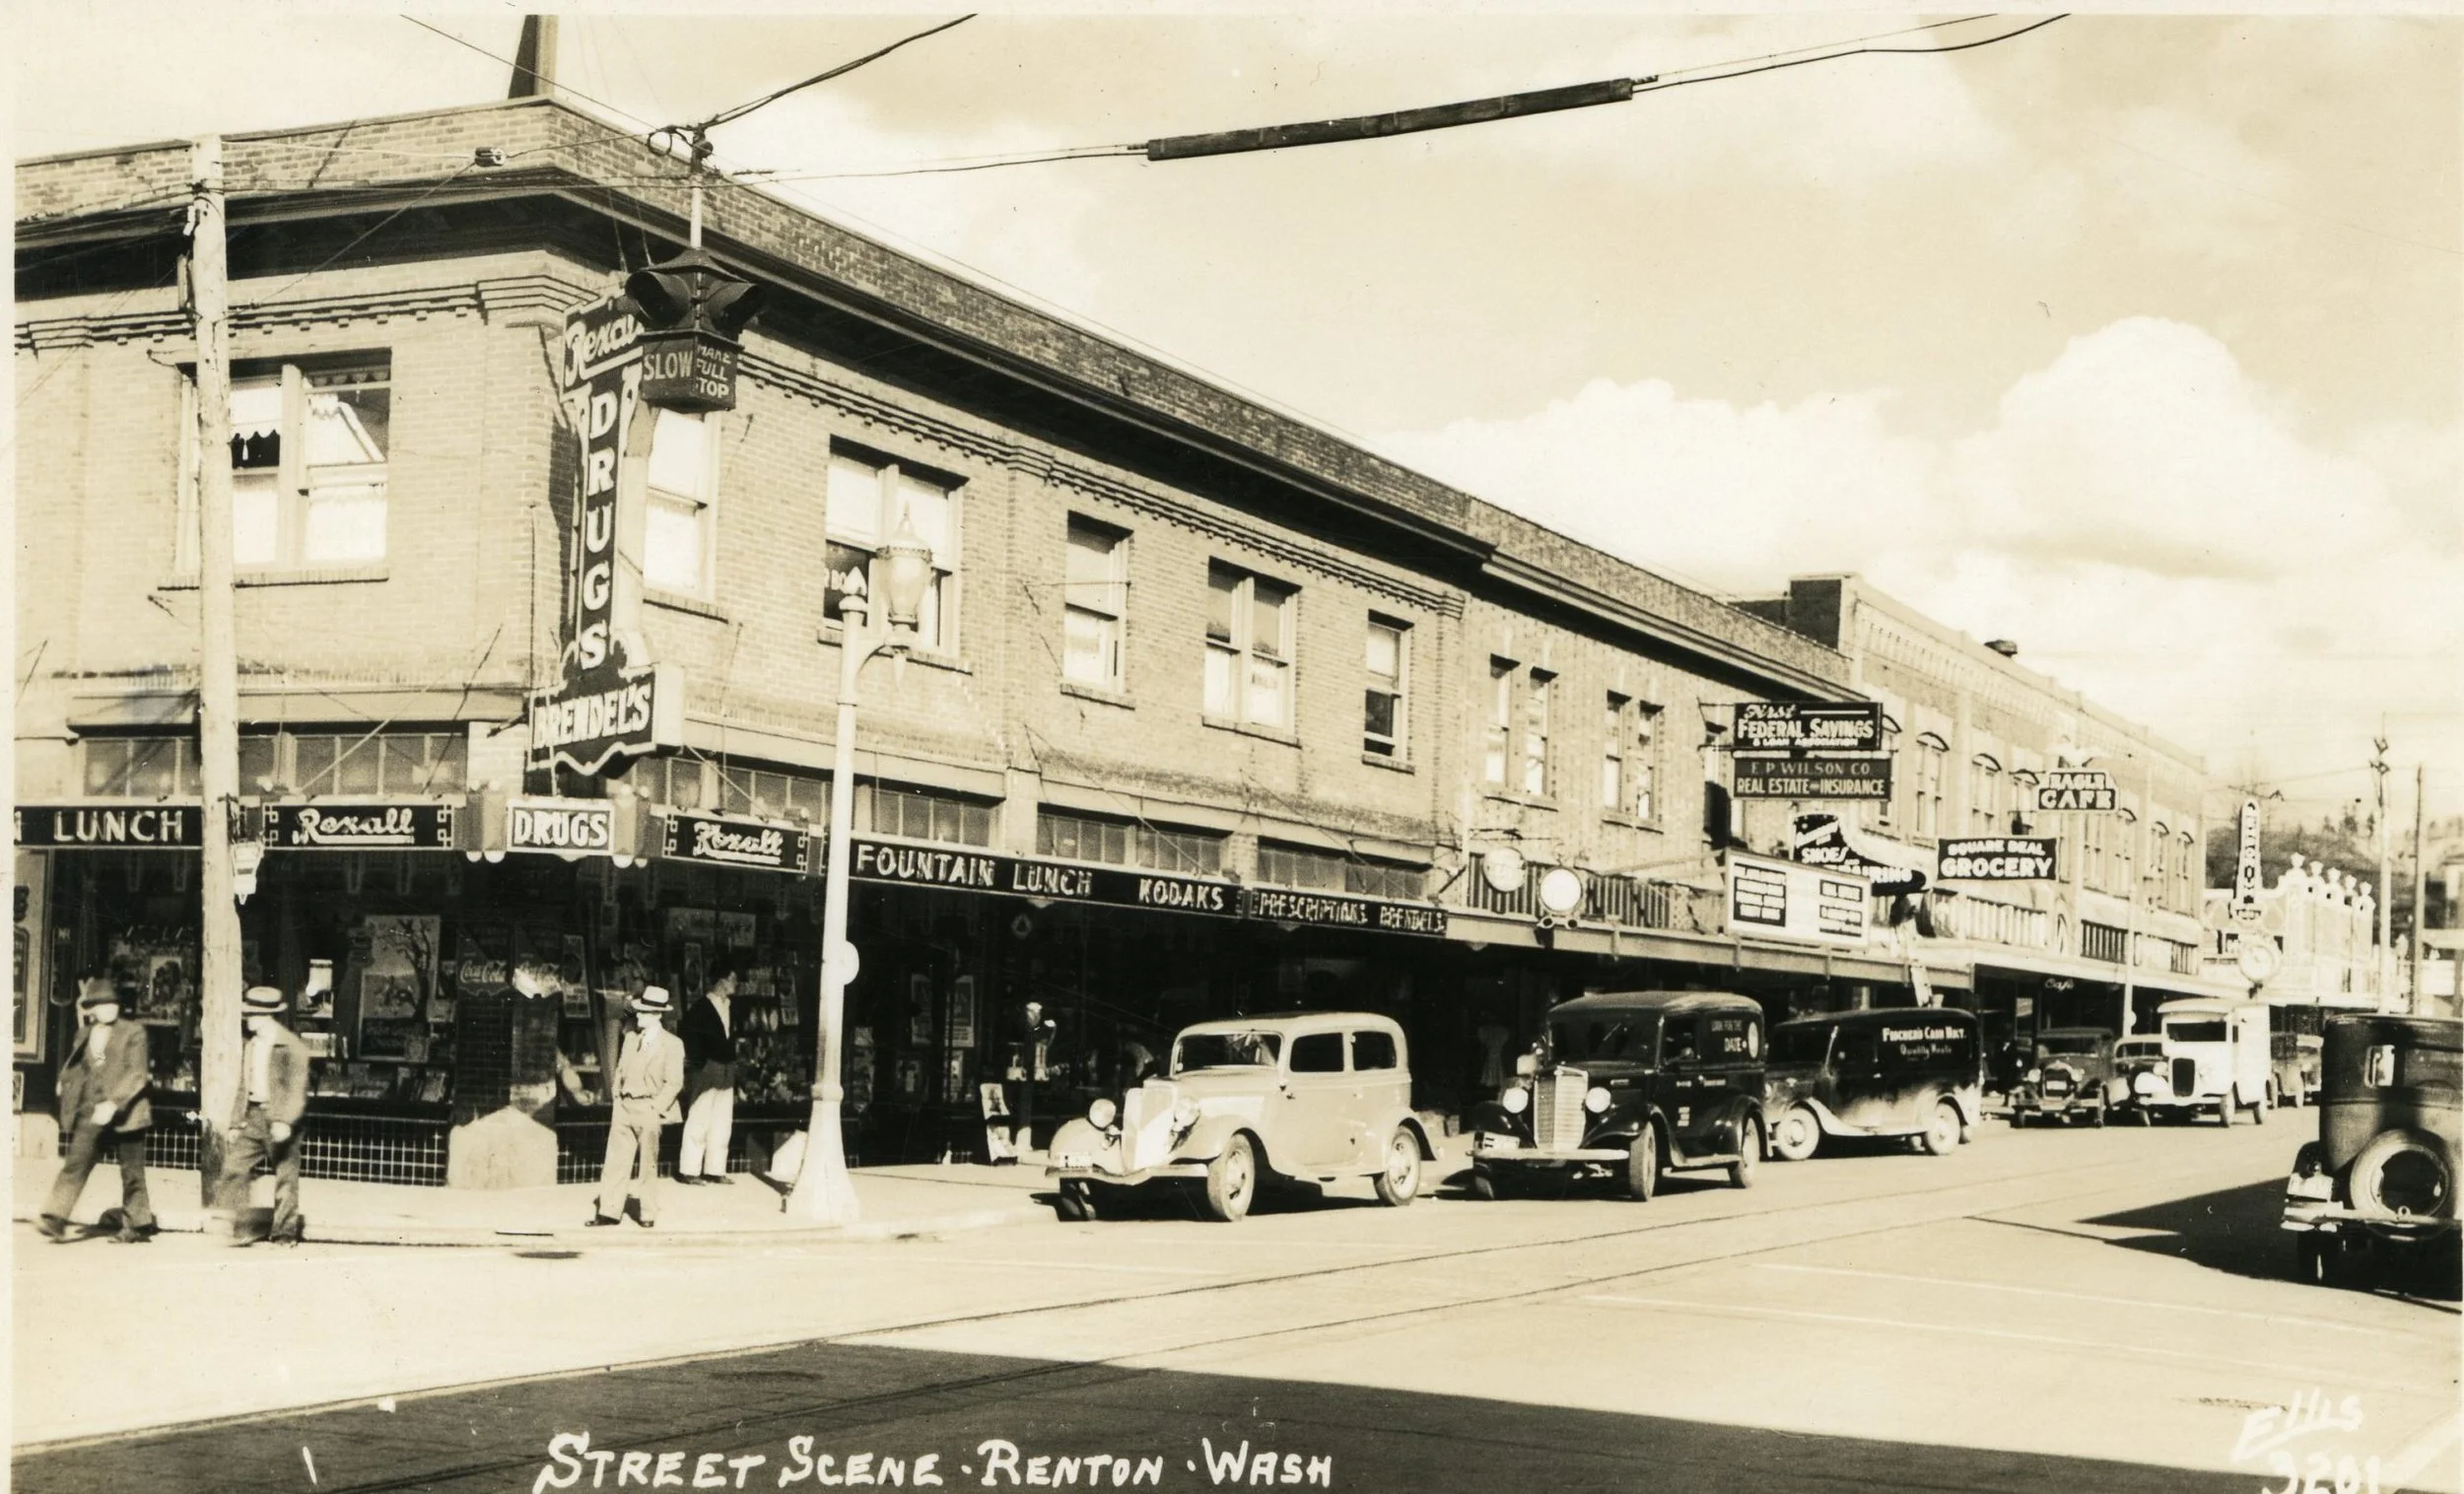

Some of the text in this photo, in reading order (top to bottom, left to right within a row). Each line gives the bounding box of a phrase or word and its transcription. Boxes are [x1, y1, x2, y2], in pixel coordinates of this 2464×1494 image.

[644, 350, 693, 380] SLOW
[697, 358, 727, 381] FULL
[580, 390, 619, 670] DRUGS
[1743, 704, 1797, 719] First
[1738, 717, 1875, 739] FEDERAL SAVINGS
[1780, 762, 1845, 777] WILSON
[1737, 778, 1766, 794] REAL
[2040, 789, 2112, 809] CAFE
[53, 810, 183, 843] LUNCH
[293, 807, 415, 845] Rexall
[513, 810, 608, 848] DRUGS
[693, 821, 785, 865] Rexall
[1948, 840, 2046, 856] SQUARE DEAL
[856, 844, 1224, 911] FOUNTAIN LUNCH KODAKS
[1940, 856, 2053, 877] GROCERY
